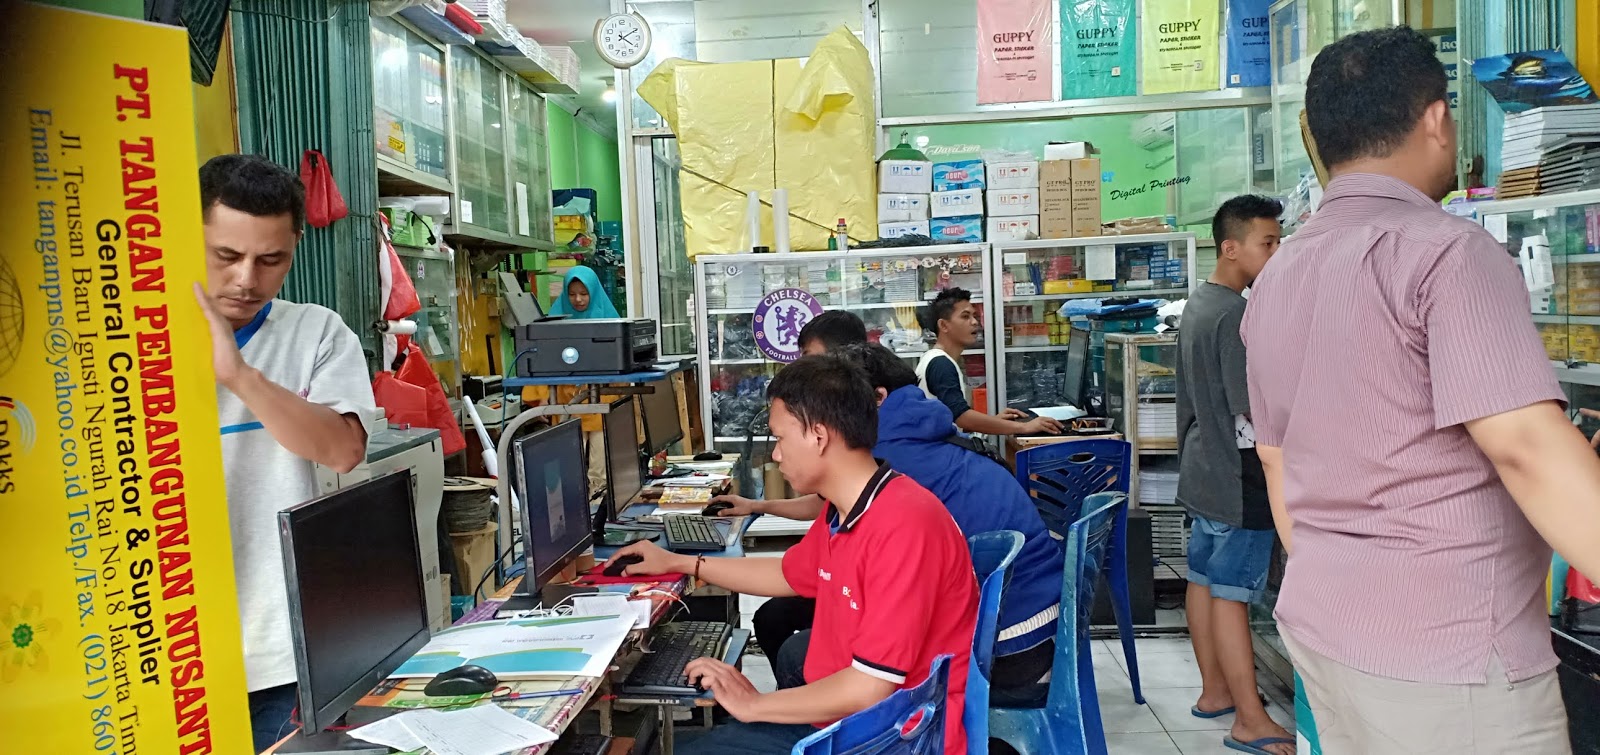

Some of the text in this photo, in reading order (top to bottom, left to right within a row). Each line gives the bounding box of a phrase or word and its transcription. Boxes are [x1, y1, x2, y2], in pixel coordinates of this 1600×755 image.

[993, 29, 1035, 43] GUPPY
[1076, 25, 1118, 40] GUPPY
[1159, 18, 1202, 34] GUPPY
[114, 63, 152, 122] PT.
[60, 130, 81, 156] Jl.
[63, 167, 85, 258] Terusan
[119, 136, 166, 294] TANGAN
[1110, 175, 1191, 201] Digital Printing
[73, 266, 94, 324] Baru
[764, 289, 812, 307] CHELSEA
[74, 330, 103, 397] Igusti
[765, 347, 798, 361] FOOTBALL
[28, 107, 118, 755] Email: tanganpns@yahoo.co.id Telp./Fax. (021) 860
[82, 404, 113, 492] Ngurah
[96, 219, 161, 685] General Contractor & Supplier
[134, 303, 195, 601] PEMBANGUNAN
[95, 499, 119, 538] Rai
[100, 544, 126, 616] No.18
[109, 623, 131, 704] Jakarta
